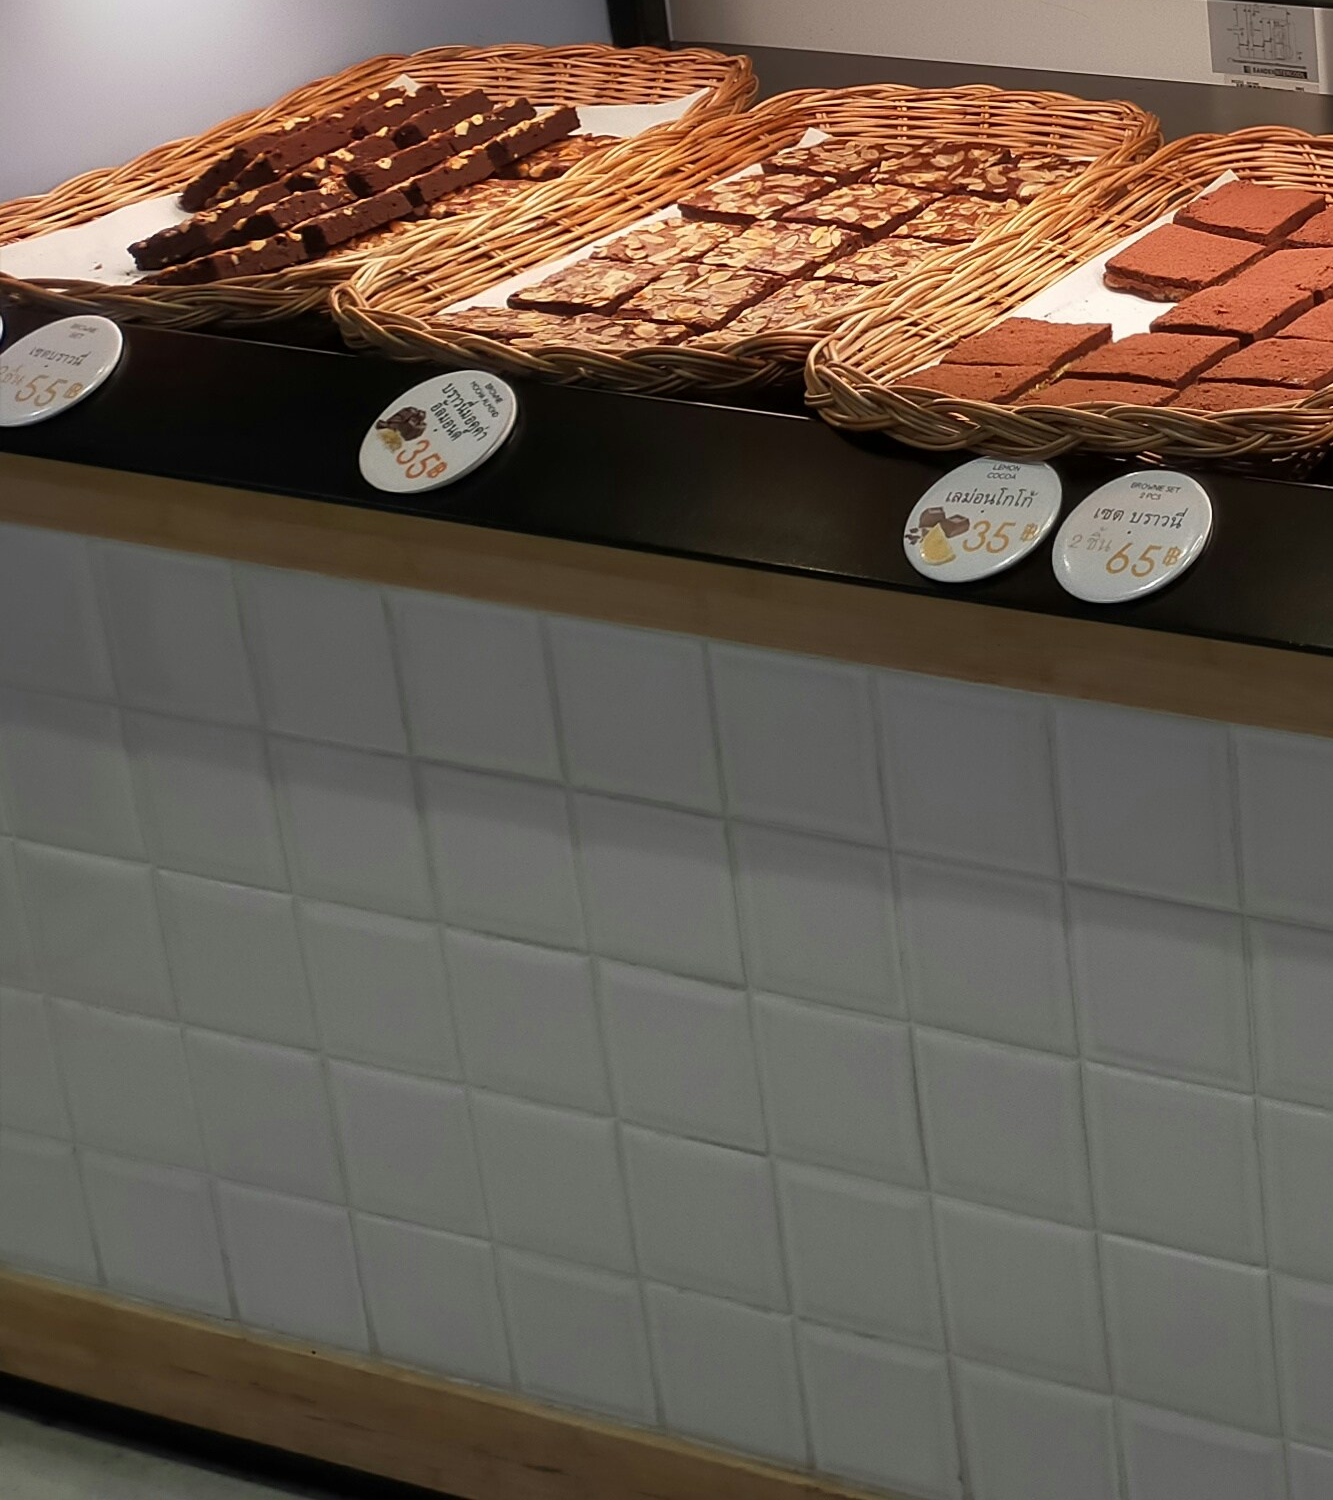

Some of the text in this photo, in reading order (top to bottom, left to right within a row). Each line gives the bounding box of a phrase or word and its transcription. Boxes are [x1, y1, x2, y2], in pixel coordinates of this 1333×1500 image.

[993, 464, 1021, 472] LEMON
[1165, 485, 1182, 493] SET
[1068, 534, 1084, 548] 2
